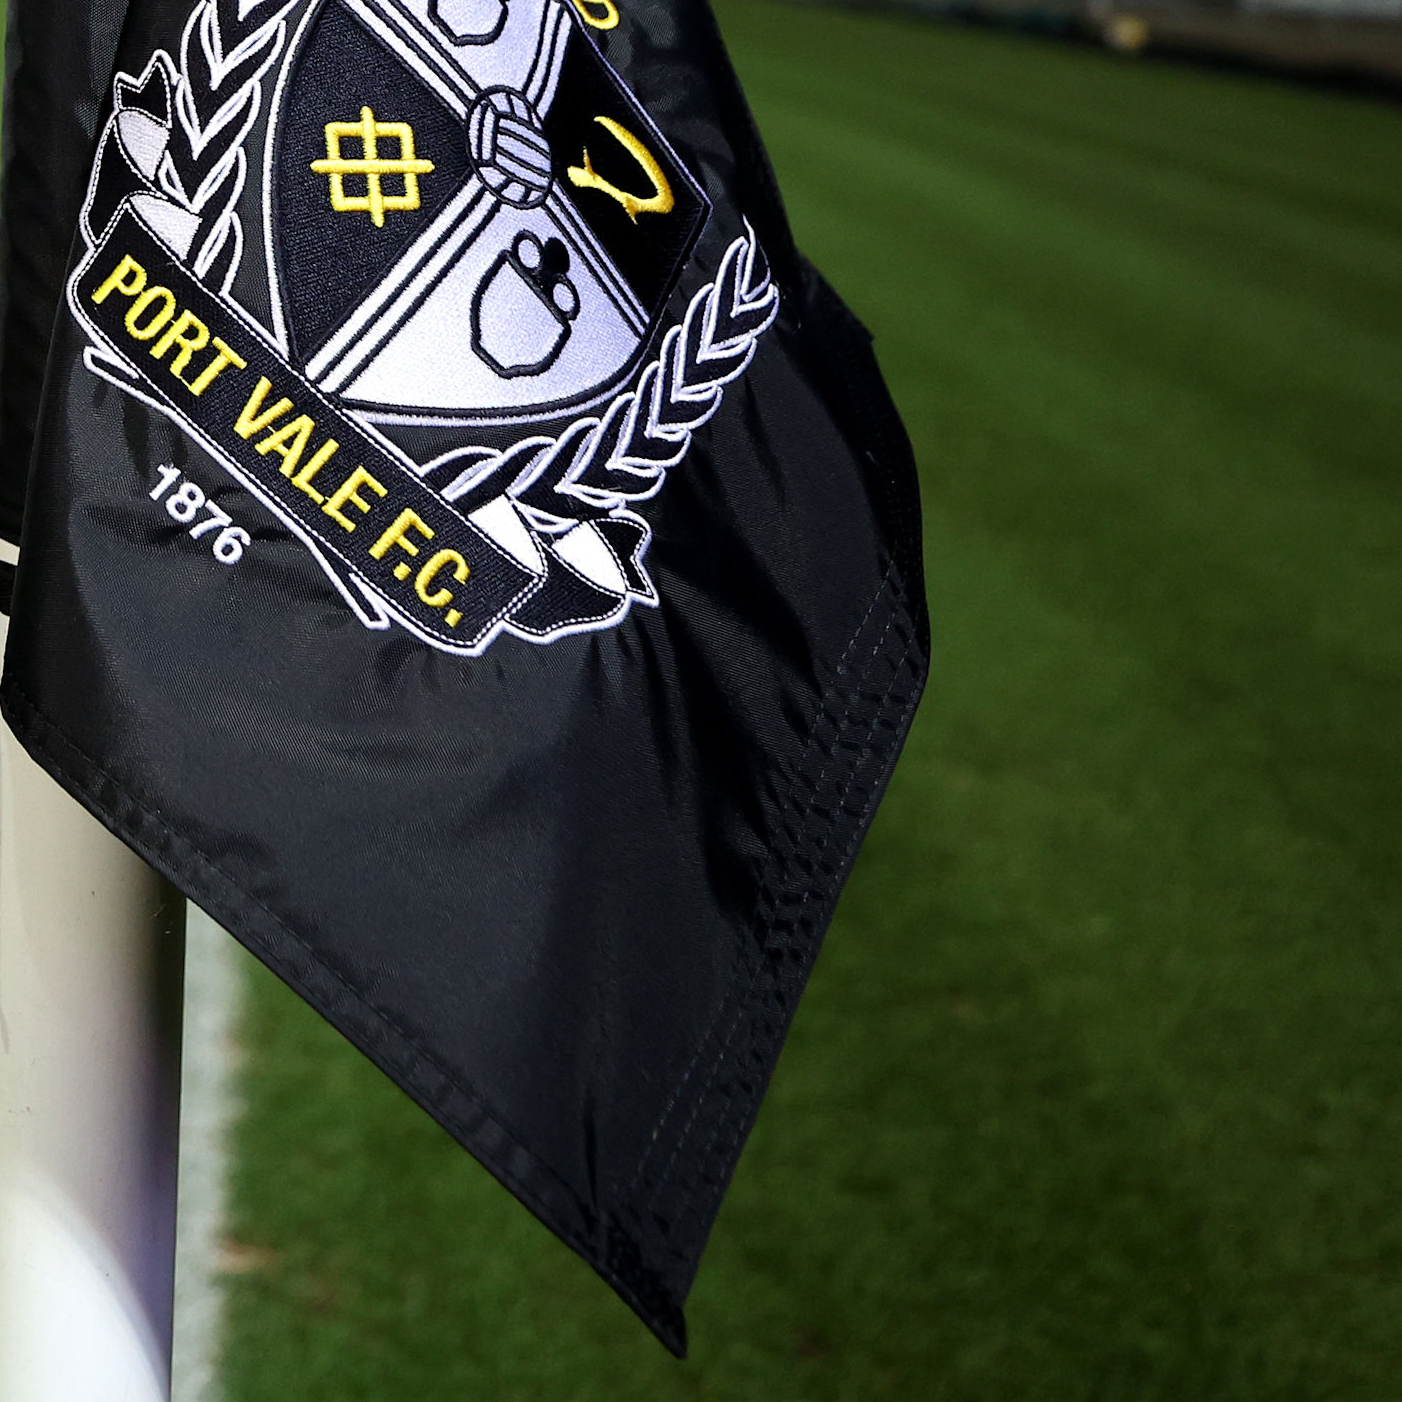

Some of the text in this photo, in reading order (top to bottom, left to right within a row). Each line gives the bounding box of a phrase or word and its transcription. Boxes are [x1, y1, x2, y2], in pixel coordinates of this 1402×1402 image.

[90, 254, 471, 628] PORT VALE F.C.
[147, 461, 252, 566] 1876
